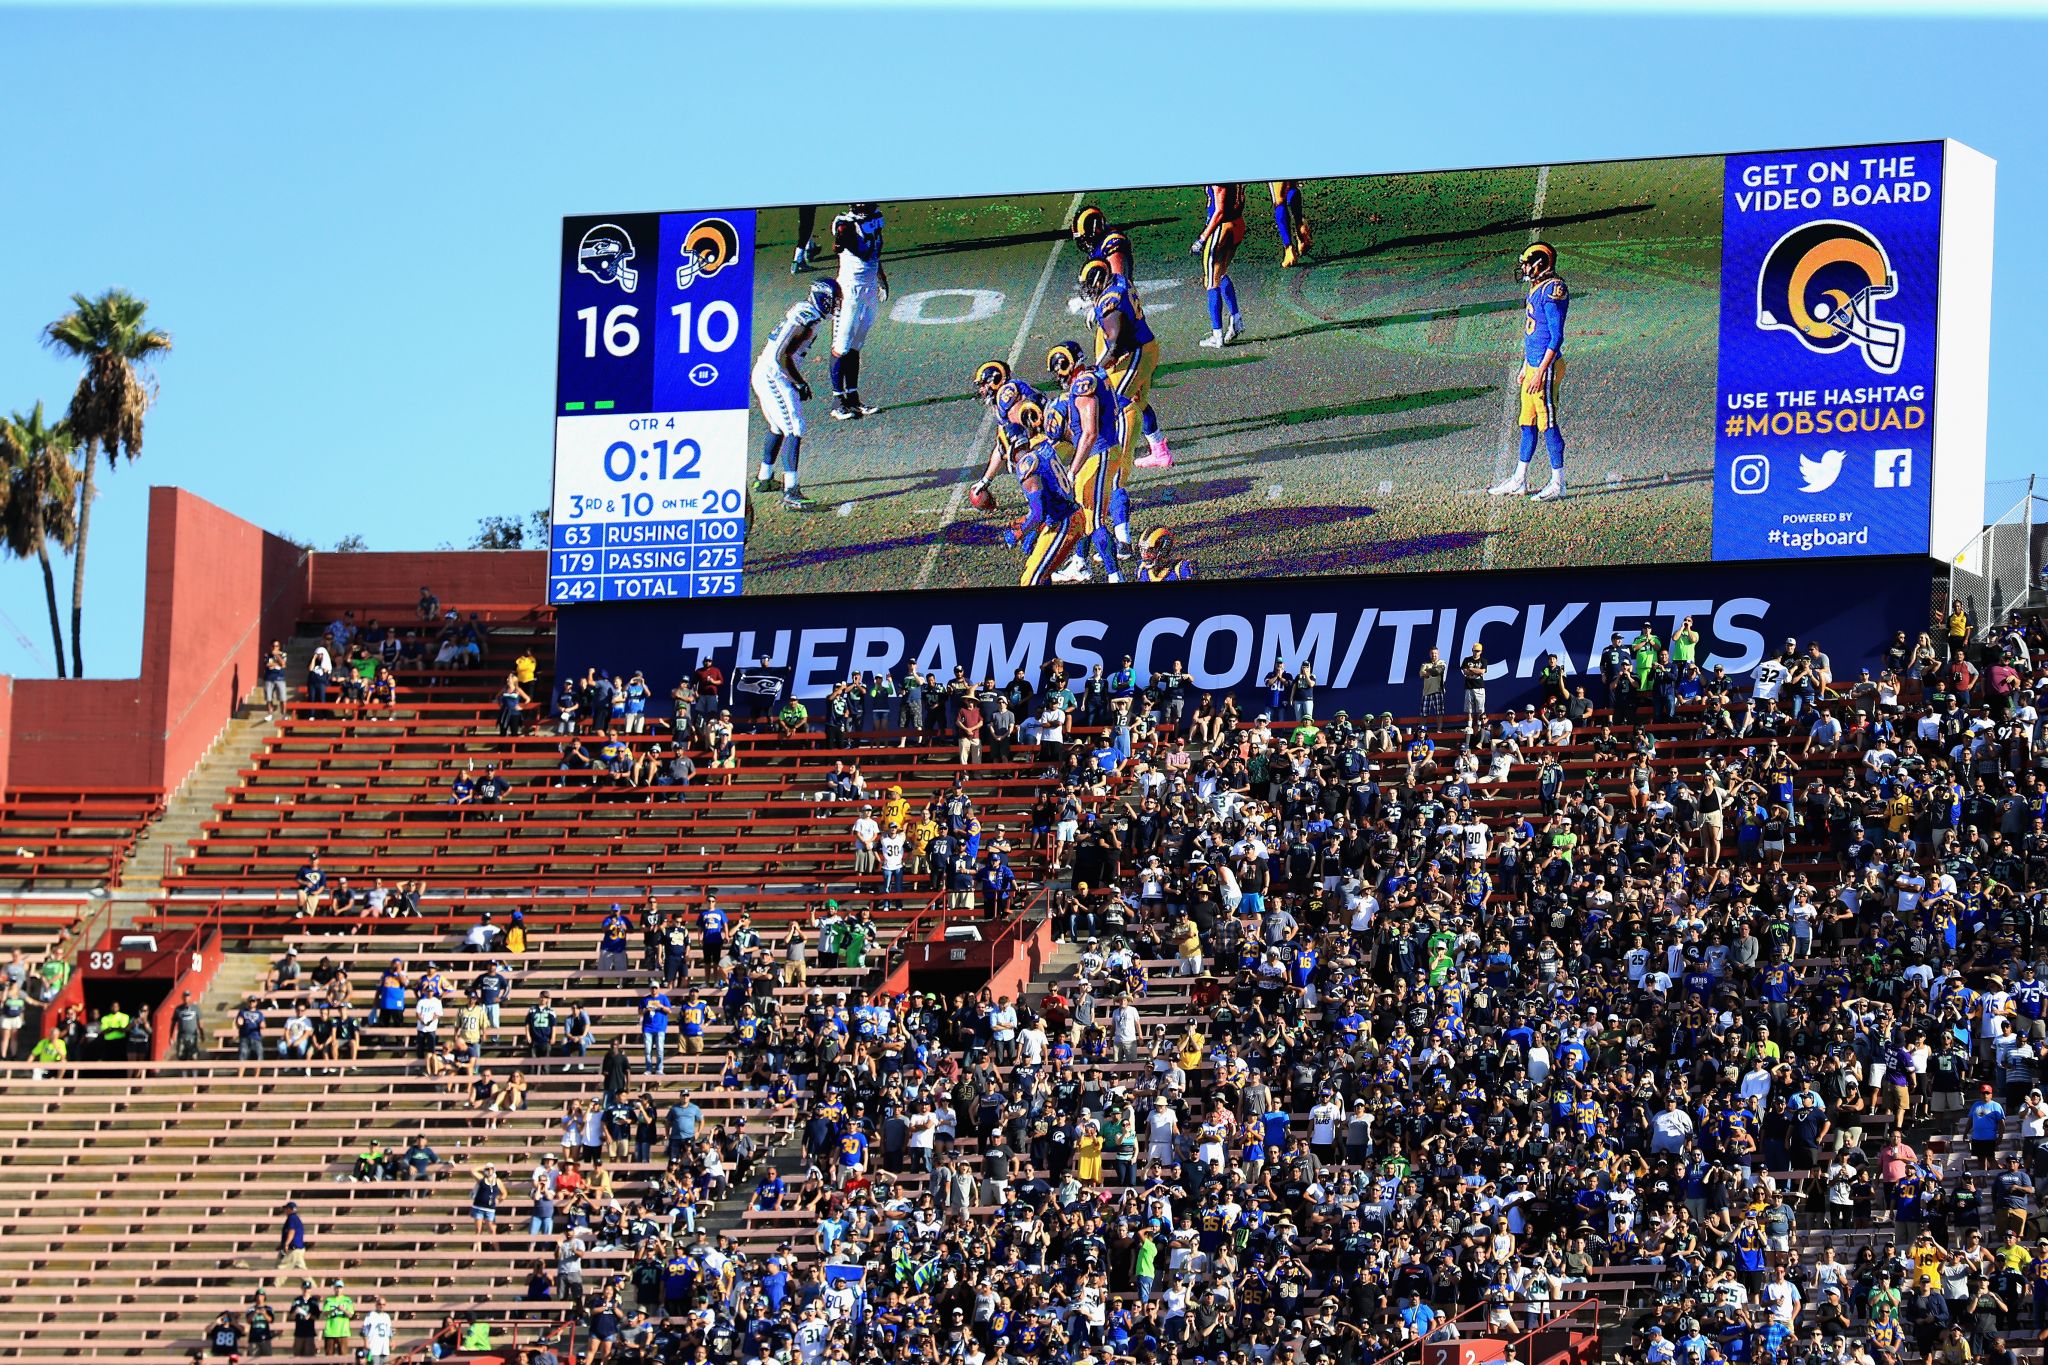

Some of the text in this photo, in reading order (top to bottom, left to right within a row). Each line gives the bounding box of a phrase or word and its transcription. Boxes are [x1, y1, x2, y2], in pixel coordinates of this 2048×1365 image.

[1742, 156, 1916, 187] GET ON THE
[1734, 180, 1932, 213] VIDEO BOARD
[577, 305, 640, 358] 16
[671, 300, 739, 354] 10
[1727, 385, 1925, 410] USE THE HASHTAG
[629, 417, 675, 431] QTR 4
[1725, 405, 1925, 437] #MOBSQUAD
[603, 438, 701, 482] 0:12
[606, 500, 615, 513] &
[621, 492, 654, 517] 10
[662, 500, 677, 509] ON
[679, 499, 698, 508] THE
[701, 489, 741, 515] 20
[1782, 512, 1853, 524] POWERED BY
[564, 521, 738, 545] 63 RUSHING 100
[1767, 526, 1868, 551] #tagboard
[559, 548, 737, 573] 179 PASSING 275
[555, 575, 736, 600] 242 TOTAL 375
[1611, 652, 1619, 664] 3
[1761, 668, 1779, 683] 32
[1094, 681, 1101, 693] 3
[1117, 715, 1127, 726] 12
[1388, 806, 1401, 818] 25
[1891, 803, 1904, 815] 16
[918, 829, 930, 841] 30
[1468, 831, 1481, 844] 30
[887, 844, 900, 857] 30
[90, 951, 114, 970] 33
[1300, 957, 1311, 968] 16
[1631, 954, 1645, 965] 25
[1473, 993, 1488, 1009] 30
[2021, 988, 2040, 1003] 75
[534, 1013, 548, 1027] 25
[740, 1026, 754, 1039] 30
[842, 1139, 859, 1153] 30
[1380, 1187, 1395, 1200] 29
[632, 1221, 647, 1236] 24
[1203, 1217, 1218, 1231] 85
[668, 1263, 685, 1276] 99
[825, 1296, 842, 1308] 80
[217, 1331, 234, 1345] 88
[806, 1329, 820, 1343] 31
